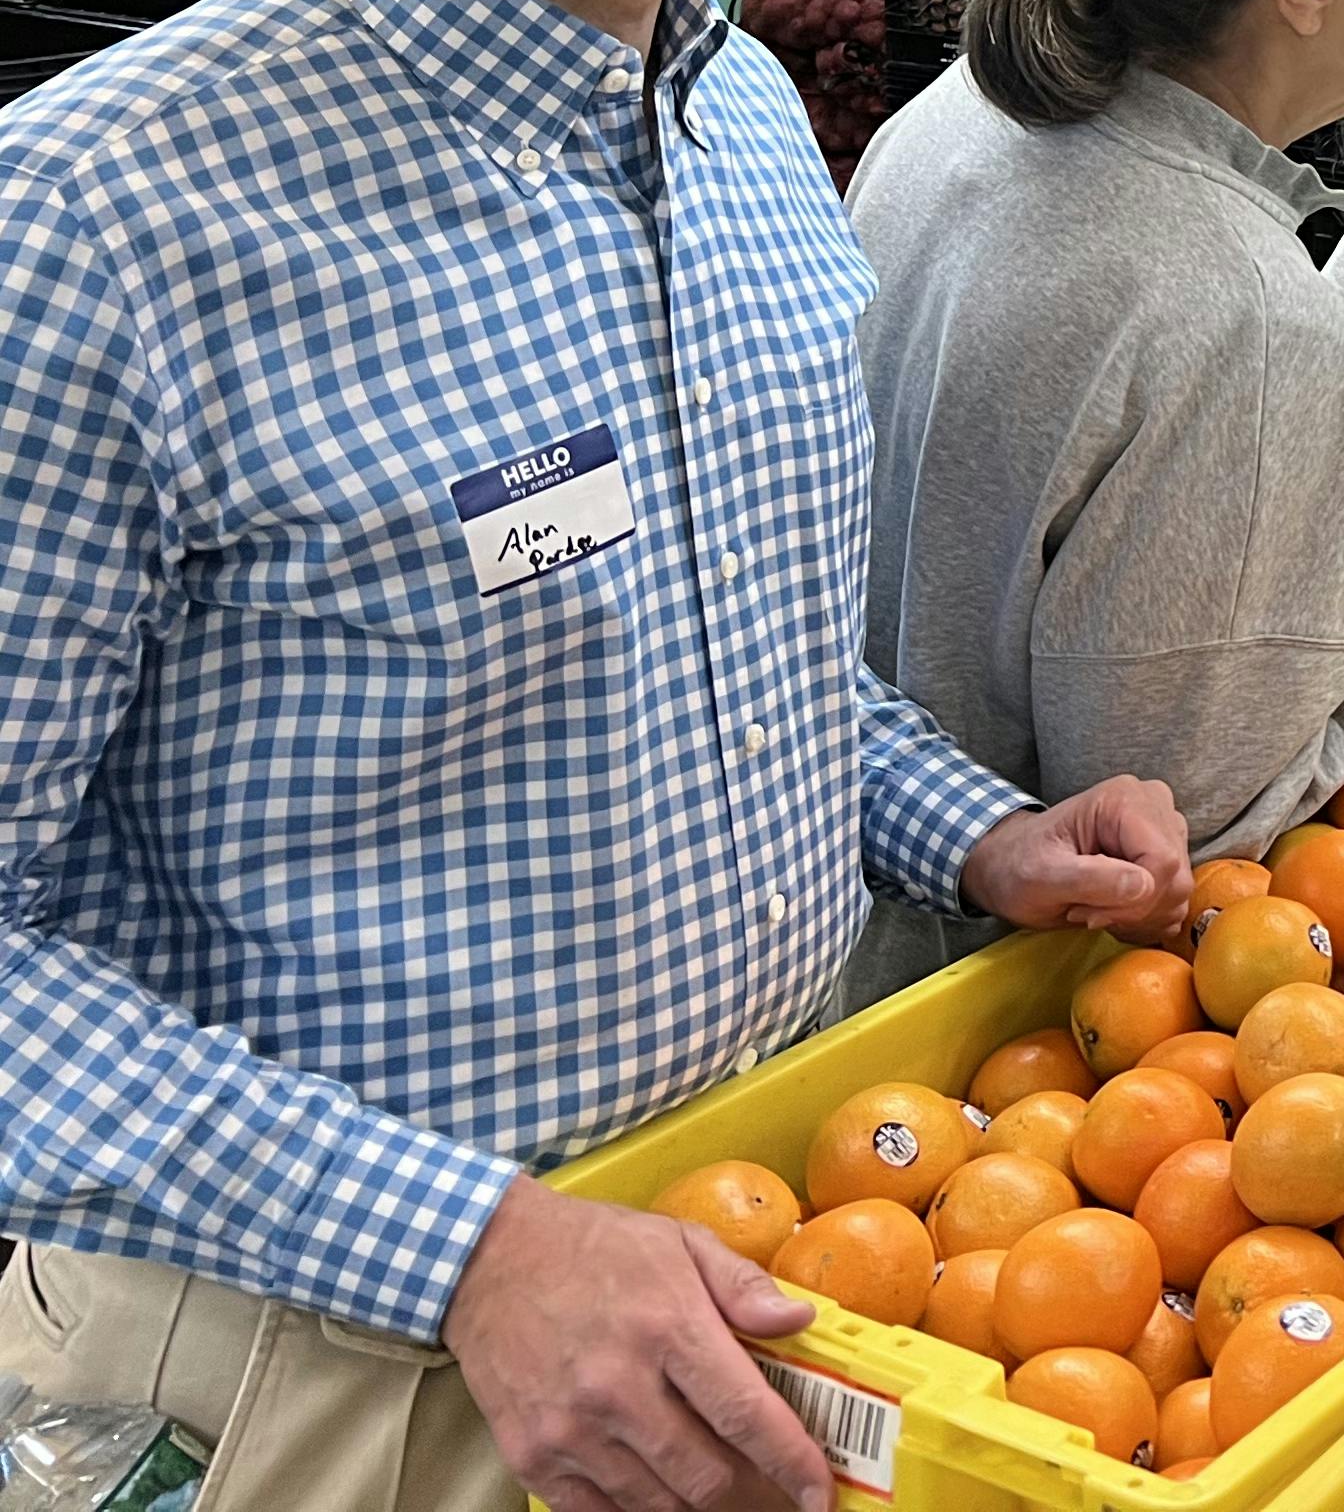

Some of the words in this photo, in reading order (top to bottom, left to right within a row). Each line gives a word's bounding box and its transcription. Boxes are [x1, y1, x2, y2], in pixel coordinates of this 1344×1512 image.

[501, 446, 571, 488] HELLO
[510, 487, 527, 500] my
[530, 470, 561, 492] name
[564, 466, 575, 477] is
[497, 522, 559, 563] Alan
